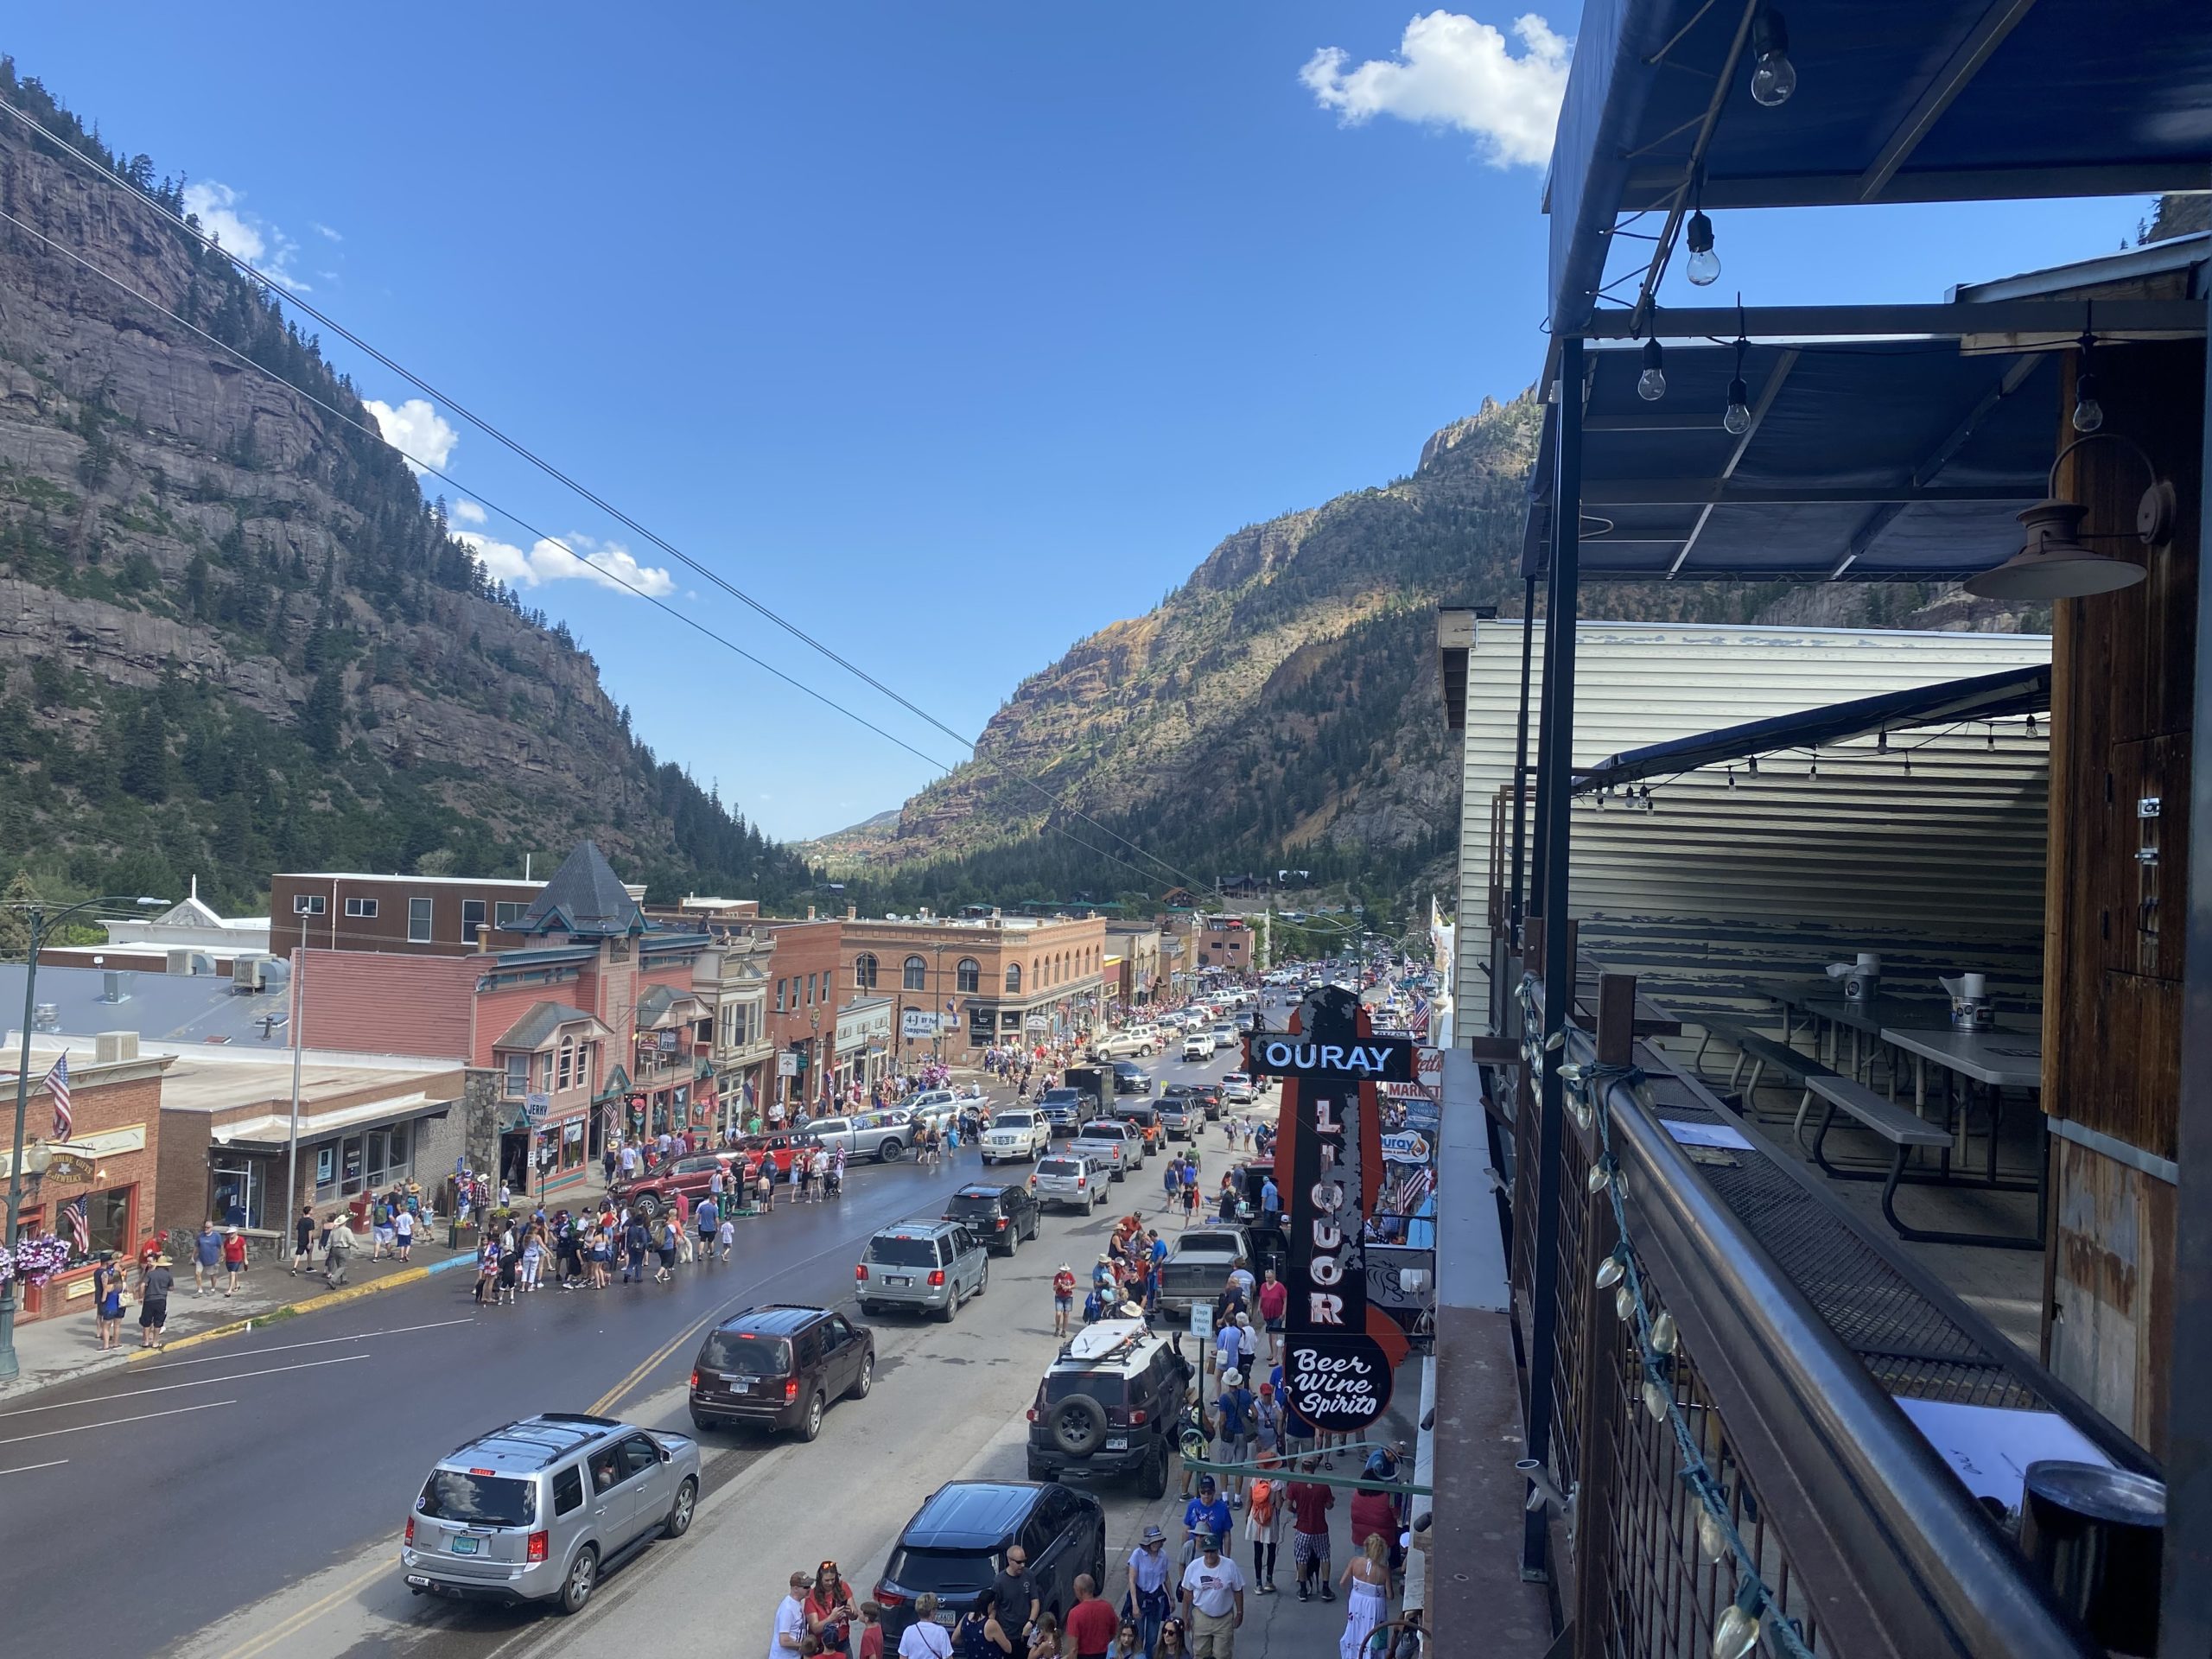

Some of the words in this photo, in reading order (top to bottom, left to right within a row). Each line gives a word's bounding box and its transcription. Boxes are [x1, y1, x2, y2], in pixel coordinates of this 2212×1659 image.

[904, 1026, 931, 1034] Campground
[1266, 1041, 1394, 1072] OURAY
[528, 1104, 548, 1116] JERKY
[1381, 1138, 1414, 1152] uray
[75, 1159, 92, 1174] GIFTS
[53, 1173, 81, 1183] JEWELRY
[1310, 1099, 1345, 1326] LIQUOR
[1293, 1349, 1372, 1374] Beer
[1294, 1373, 1373, 1393] Wine
[1299, 1393, 1377, 1418] Spirits
